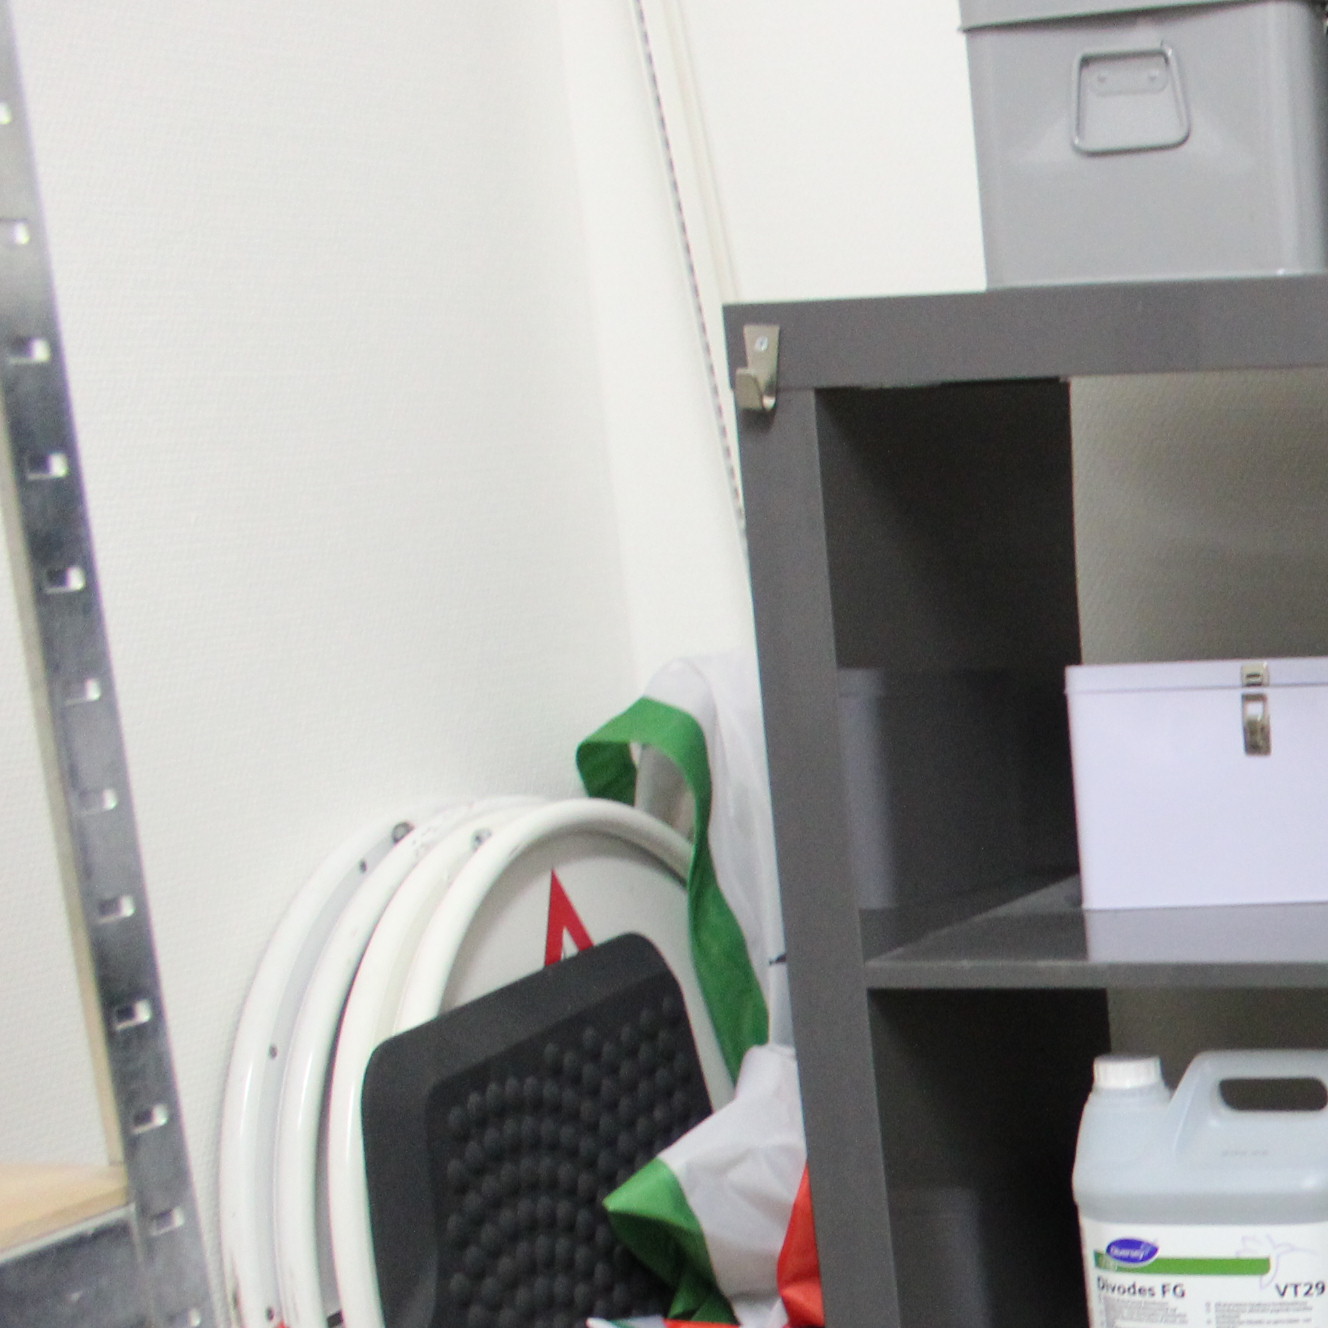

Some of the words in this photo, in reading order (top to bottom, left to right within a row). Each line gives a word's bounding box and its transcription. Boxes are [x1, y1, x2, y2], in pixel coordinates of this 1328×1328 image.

[1097, 1276, 1156, 1297] Divodes
[1161, 1283, 1186, 1299] FG
[1275, 1281, 1326, 1298] VT29
